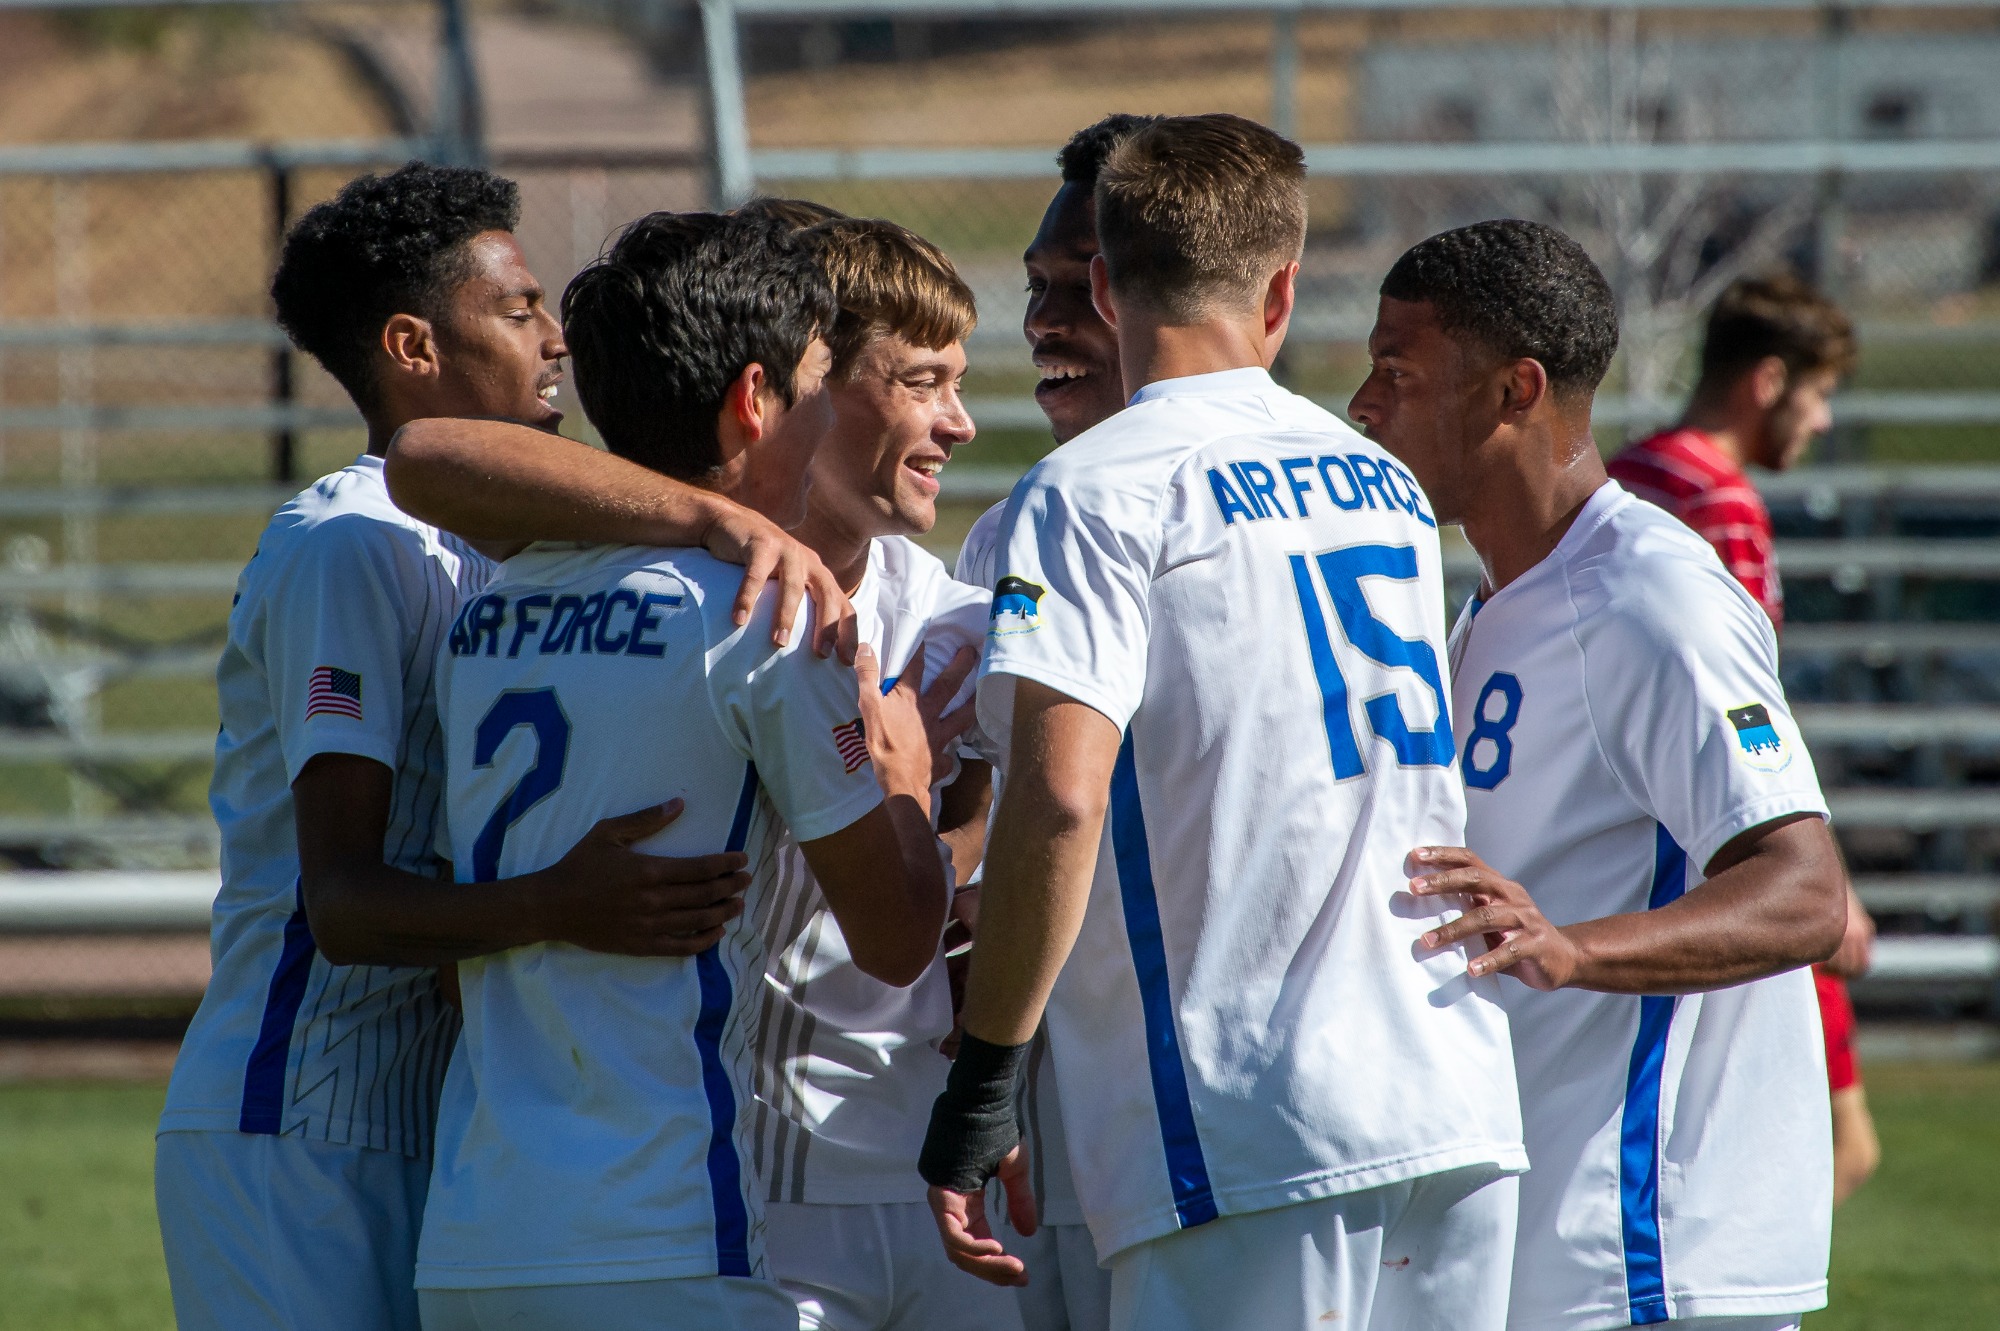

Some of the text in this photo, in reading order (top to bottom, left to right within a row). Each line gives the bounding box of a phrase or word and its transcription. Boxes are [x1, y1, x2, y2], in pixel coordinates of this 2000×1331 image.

[1205, 453, 1437, 530] AIR FORCE
[449, 590, 685, 659] AIR FORCE
[1285, 541, 1457, 786] 15
[473, 685, 573, 883] 2
[1461, 670, 1525, 792] 8
